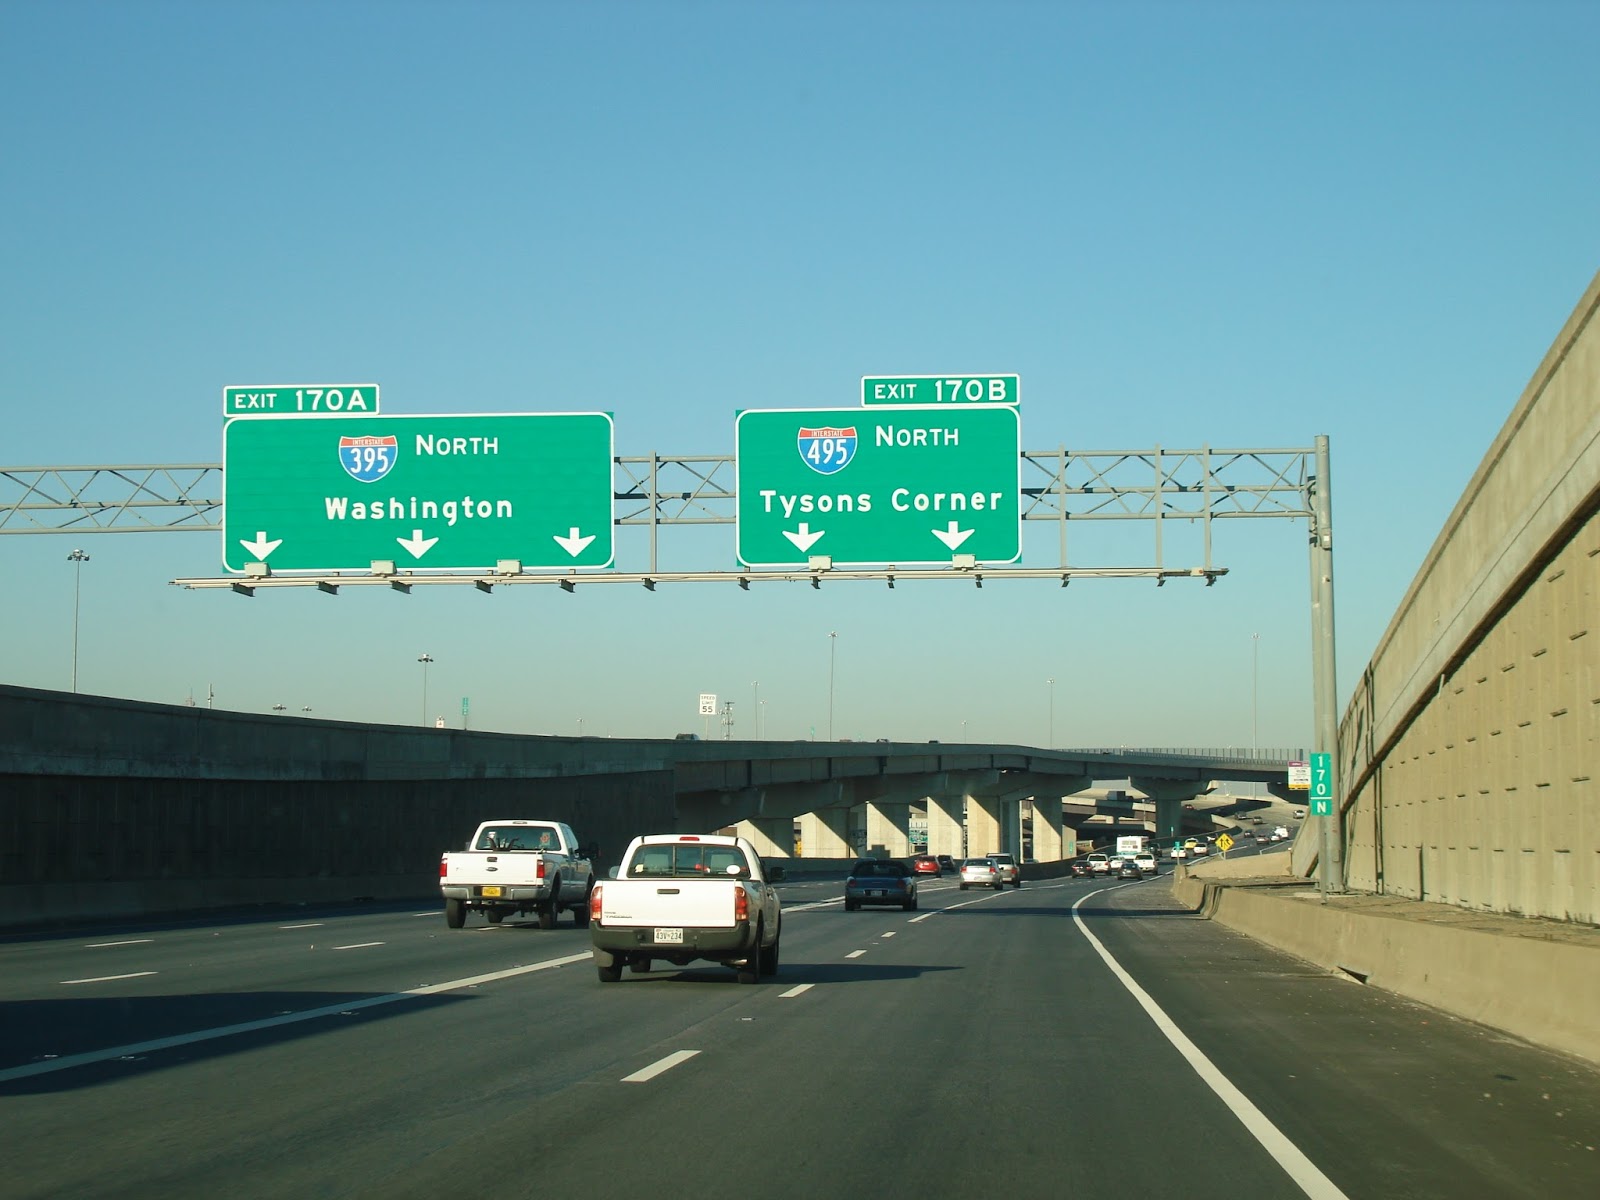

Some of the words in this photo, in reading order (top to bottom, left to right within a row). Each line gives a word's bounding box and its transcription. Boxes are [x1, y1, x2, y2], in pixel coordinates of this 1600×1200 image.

[235, 394, 277, 409] EXIT
[296, 389, 367, 411] 170A
[874, 384, 917, 399] EXIT
[935, 380, 1006, 401] 170B
[352, 438, 384, 446] INTERSTATE
[416, 434, 498, 456] NORTH
[875, 425, 959, 447] NORTH
[350, 447, 389, 474] 395
[807, 438, 848, 465] 495
[325, 496, 513, 527] Washington
[760, 490, 872, 518] Tysons
[891, 488, 1003, 512] Corner
[702, 705, 713, 713] 55
[1316, 801, 1326, 813] N
